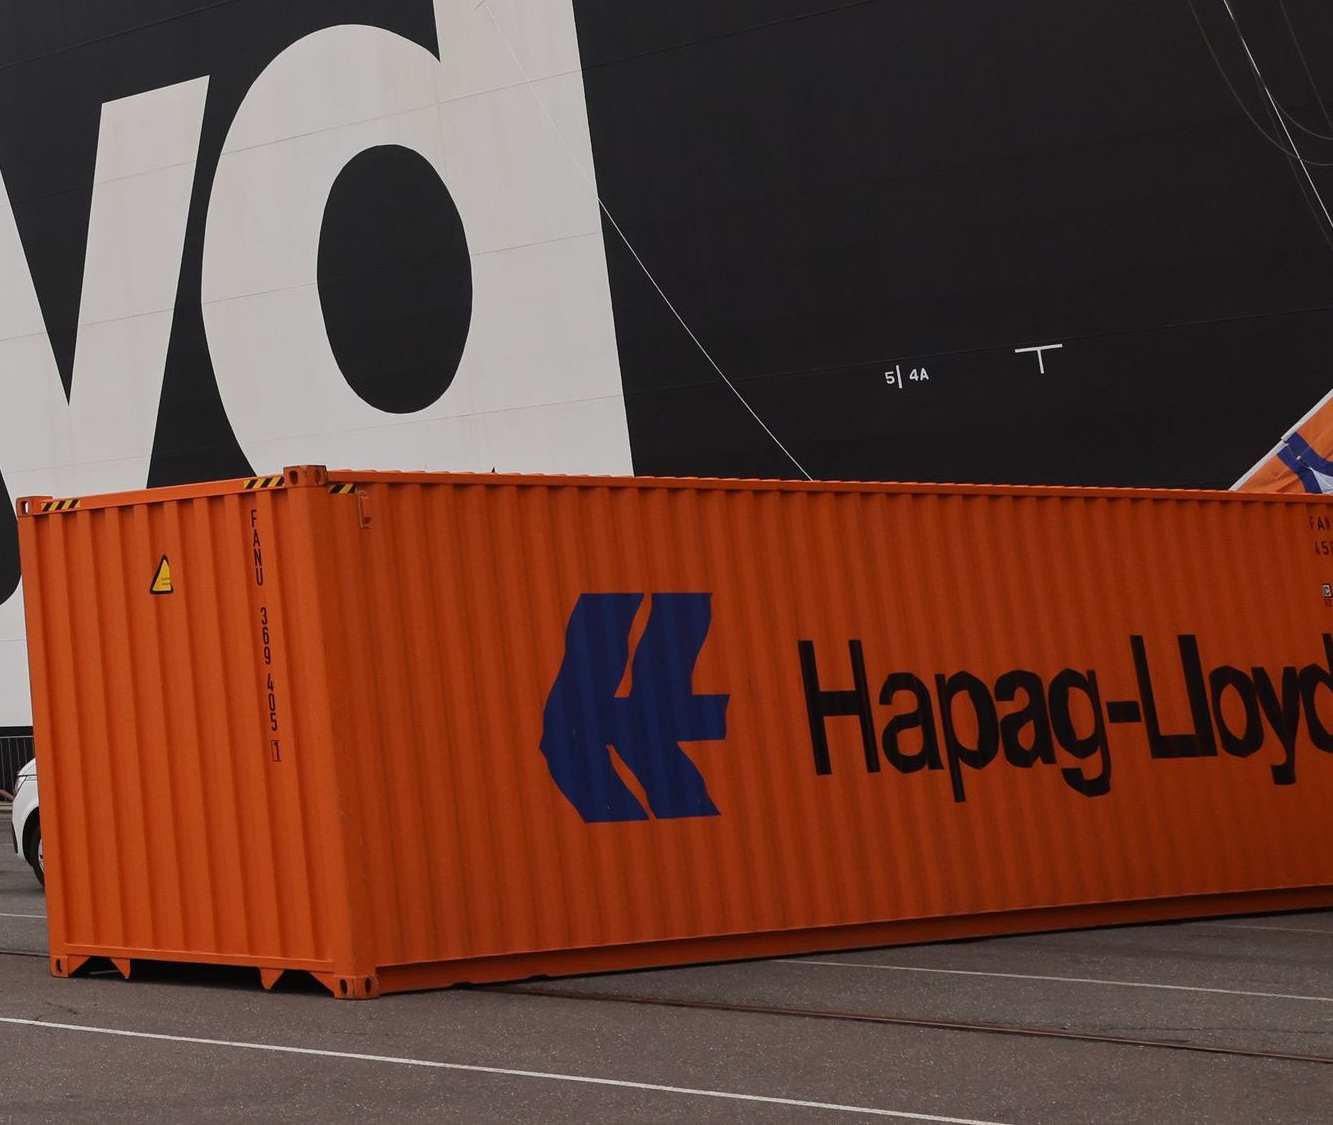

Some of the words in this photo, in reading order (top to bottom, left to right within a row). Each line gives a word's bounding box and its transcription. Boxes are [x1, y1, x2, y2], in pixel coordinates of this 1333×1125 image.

[909, 368, 930, 382] 4A
[251, 509, 263, 586] FANU
[261, 607, 271, 665] 369
[267, 674, 277, 731] 405
